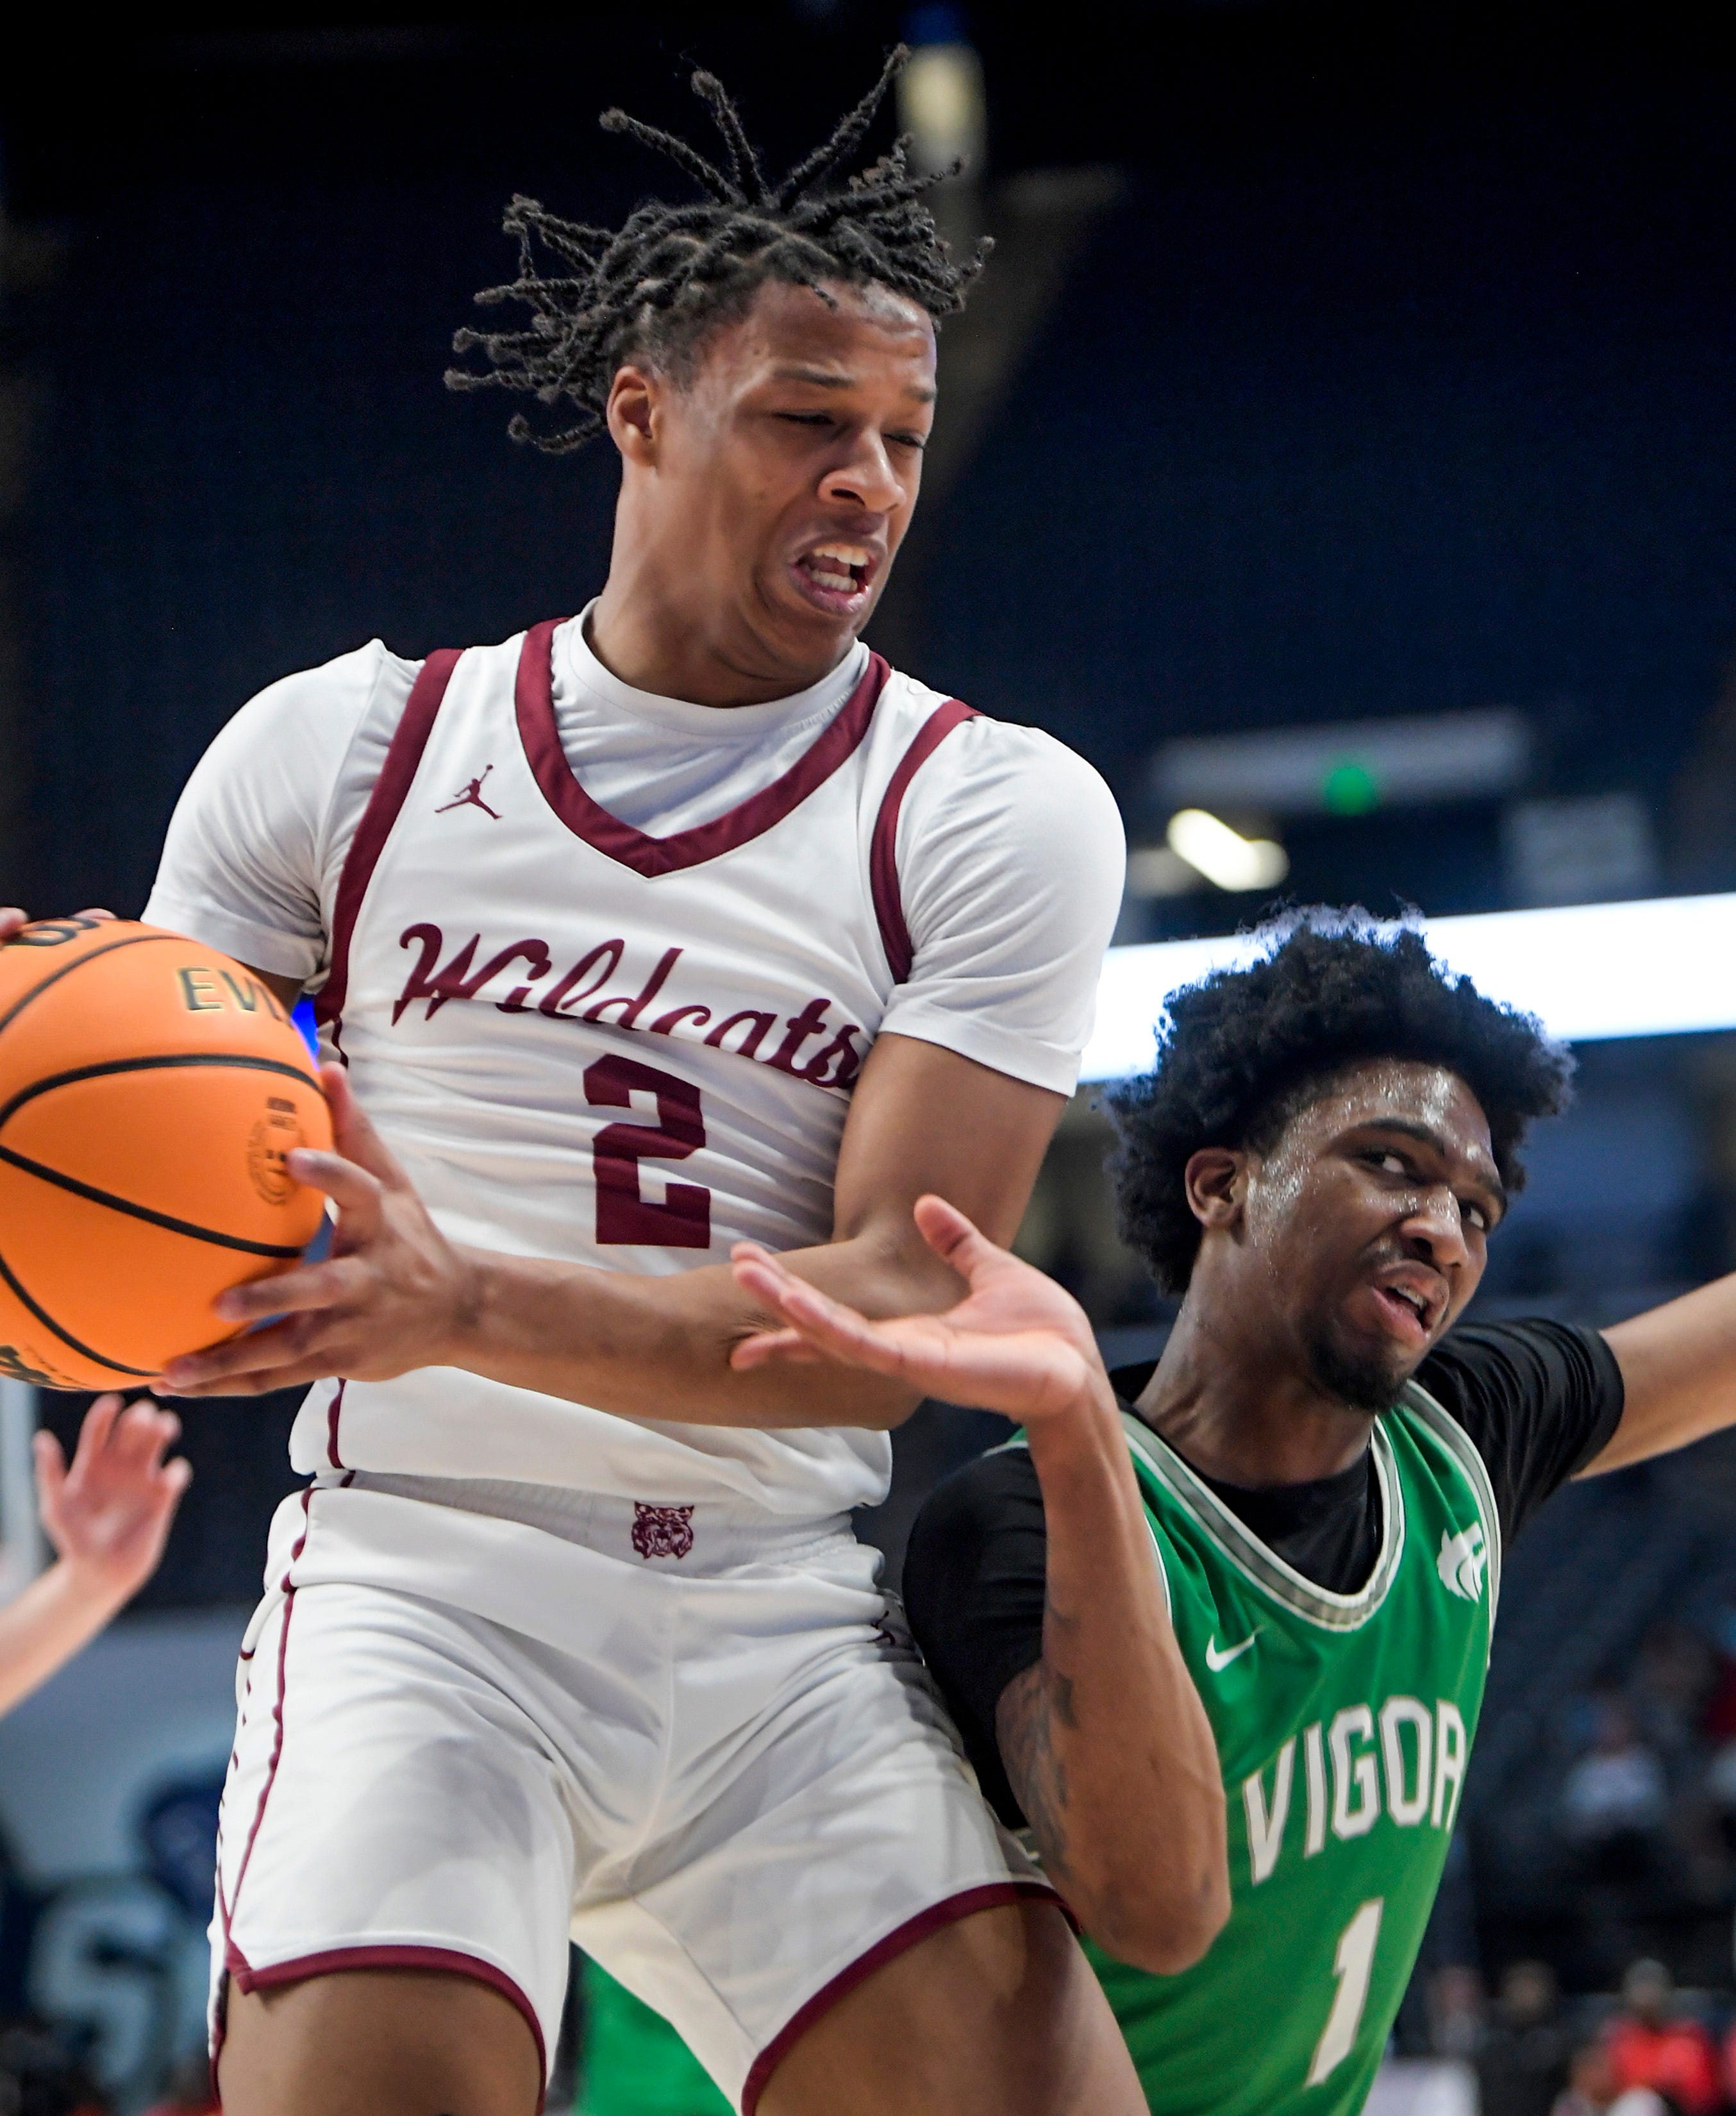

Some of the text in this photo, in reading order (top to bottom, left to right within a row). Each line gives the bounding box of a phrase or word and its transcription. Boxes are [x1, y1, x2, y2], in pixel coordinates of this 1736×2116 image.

[391, 922, 860, 1089] Wildcats
[583, 1053, 710, 1249] 2
[1242, 1694, 1466, 1887] VIGOR
[1304, 1896, 1383, 2090] 1
